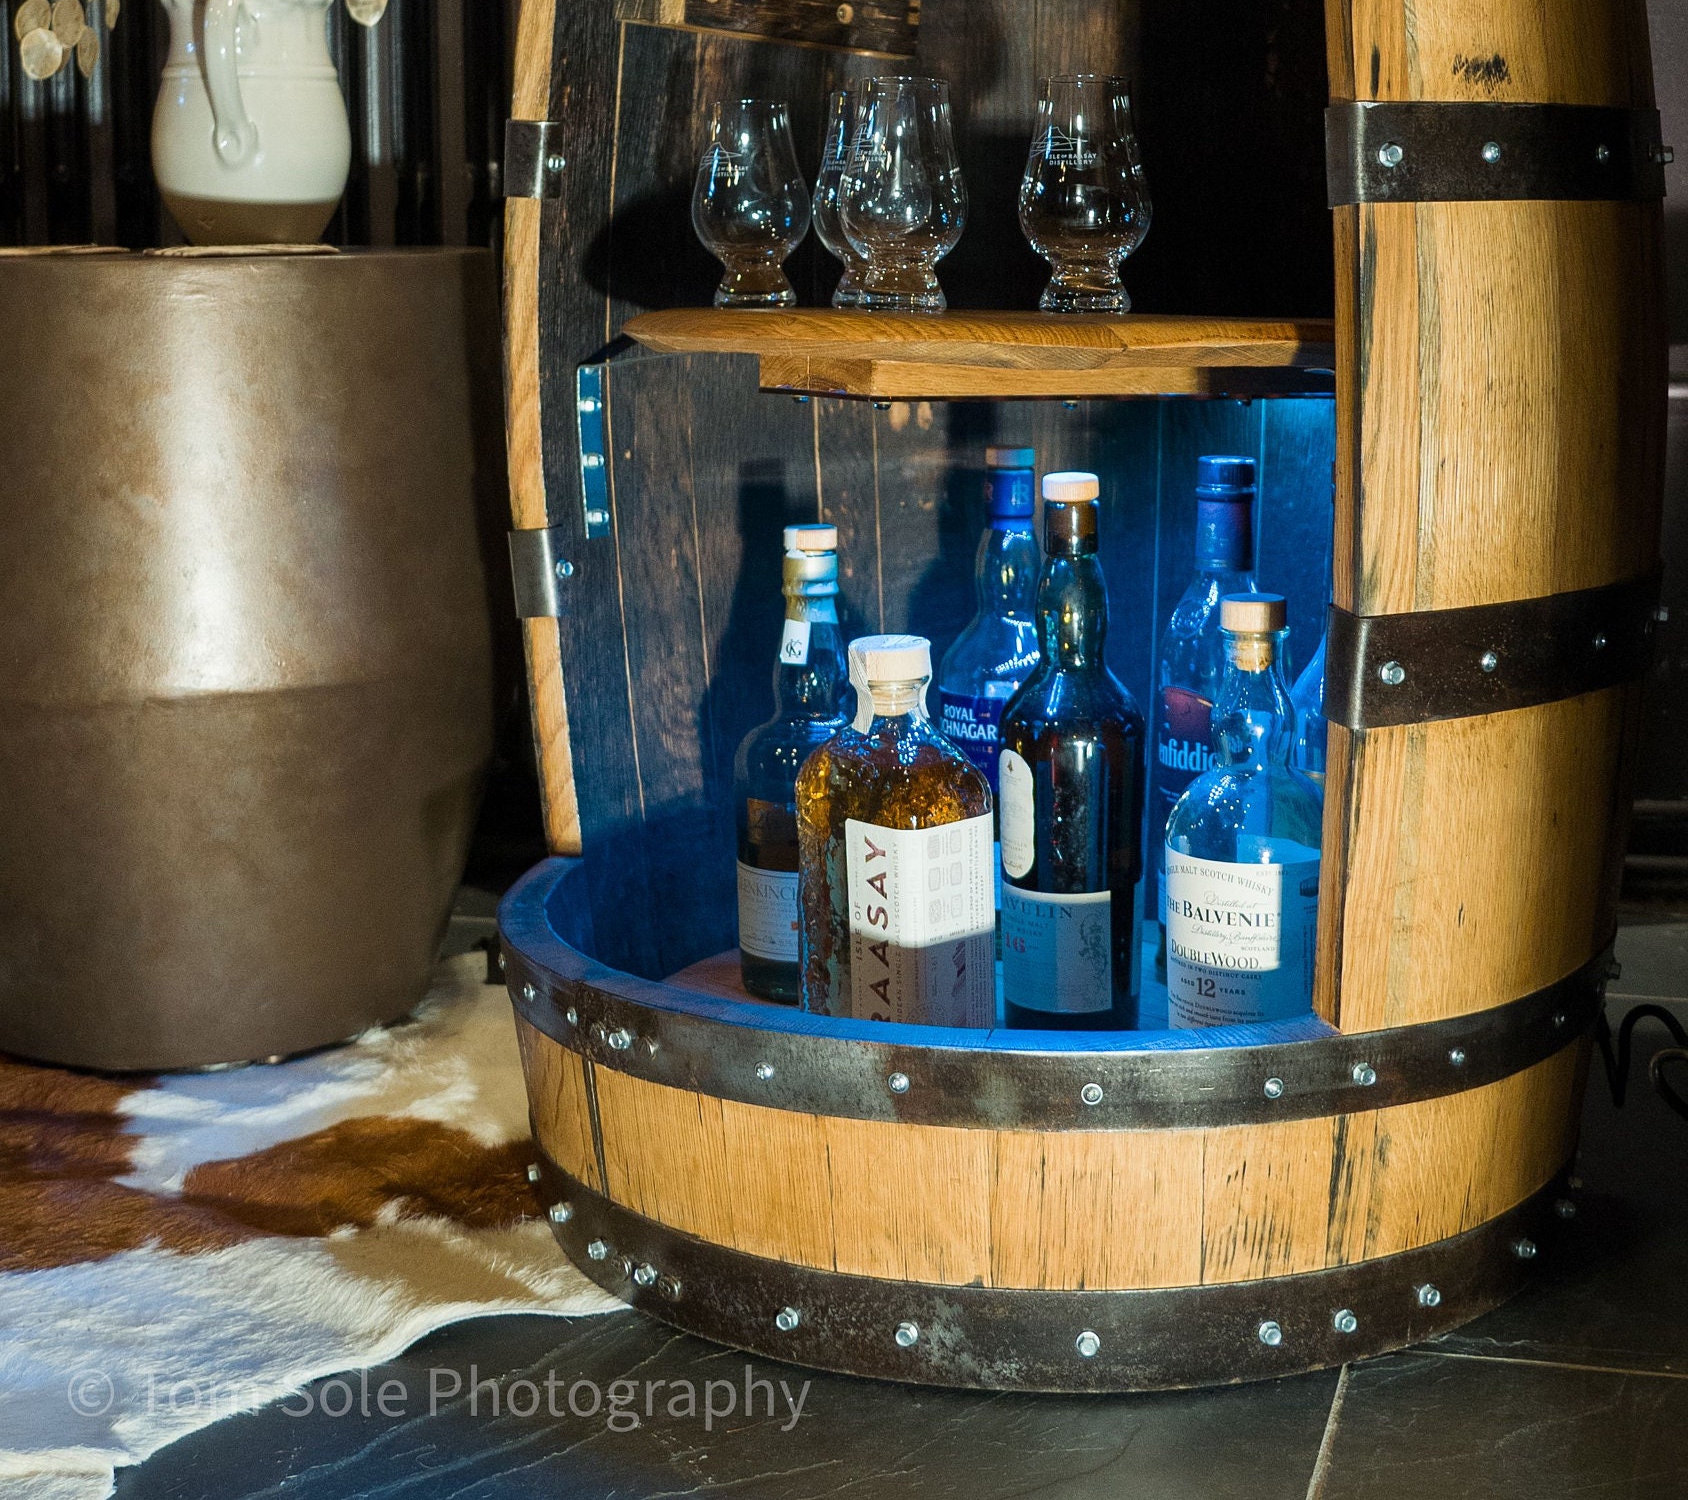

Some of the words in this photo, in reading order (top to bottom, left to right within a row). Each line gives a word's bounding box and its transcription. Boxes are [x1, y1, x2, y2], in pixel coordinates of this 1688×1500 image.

[943, 703, 977, 722] ROYAL
[1180, 865, 1198, 875] MALT
[1200, 868, 1234, 884] SCOTCH
[1238, 876, 1274, 897] WHISKY
[854, 902, 862, 922] OF
[1167, 896, 1181, 915] THE
[1183, 900, 1275, 927] BALVENIE
[855, 927, 863, 962] ISLE
[1005, 931, 1026, 953] 16
[1194, 965, 1207, 975] TWO
[1208, 970, 1240, 980] DISTINCT
[1241, 973, 1263, 981] CASKS
[1180, 976, 1195, 987] AGED
[1196, 977, 1216, 998] 12
[1219, 986, 1246, 996] YEARS
